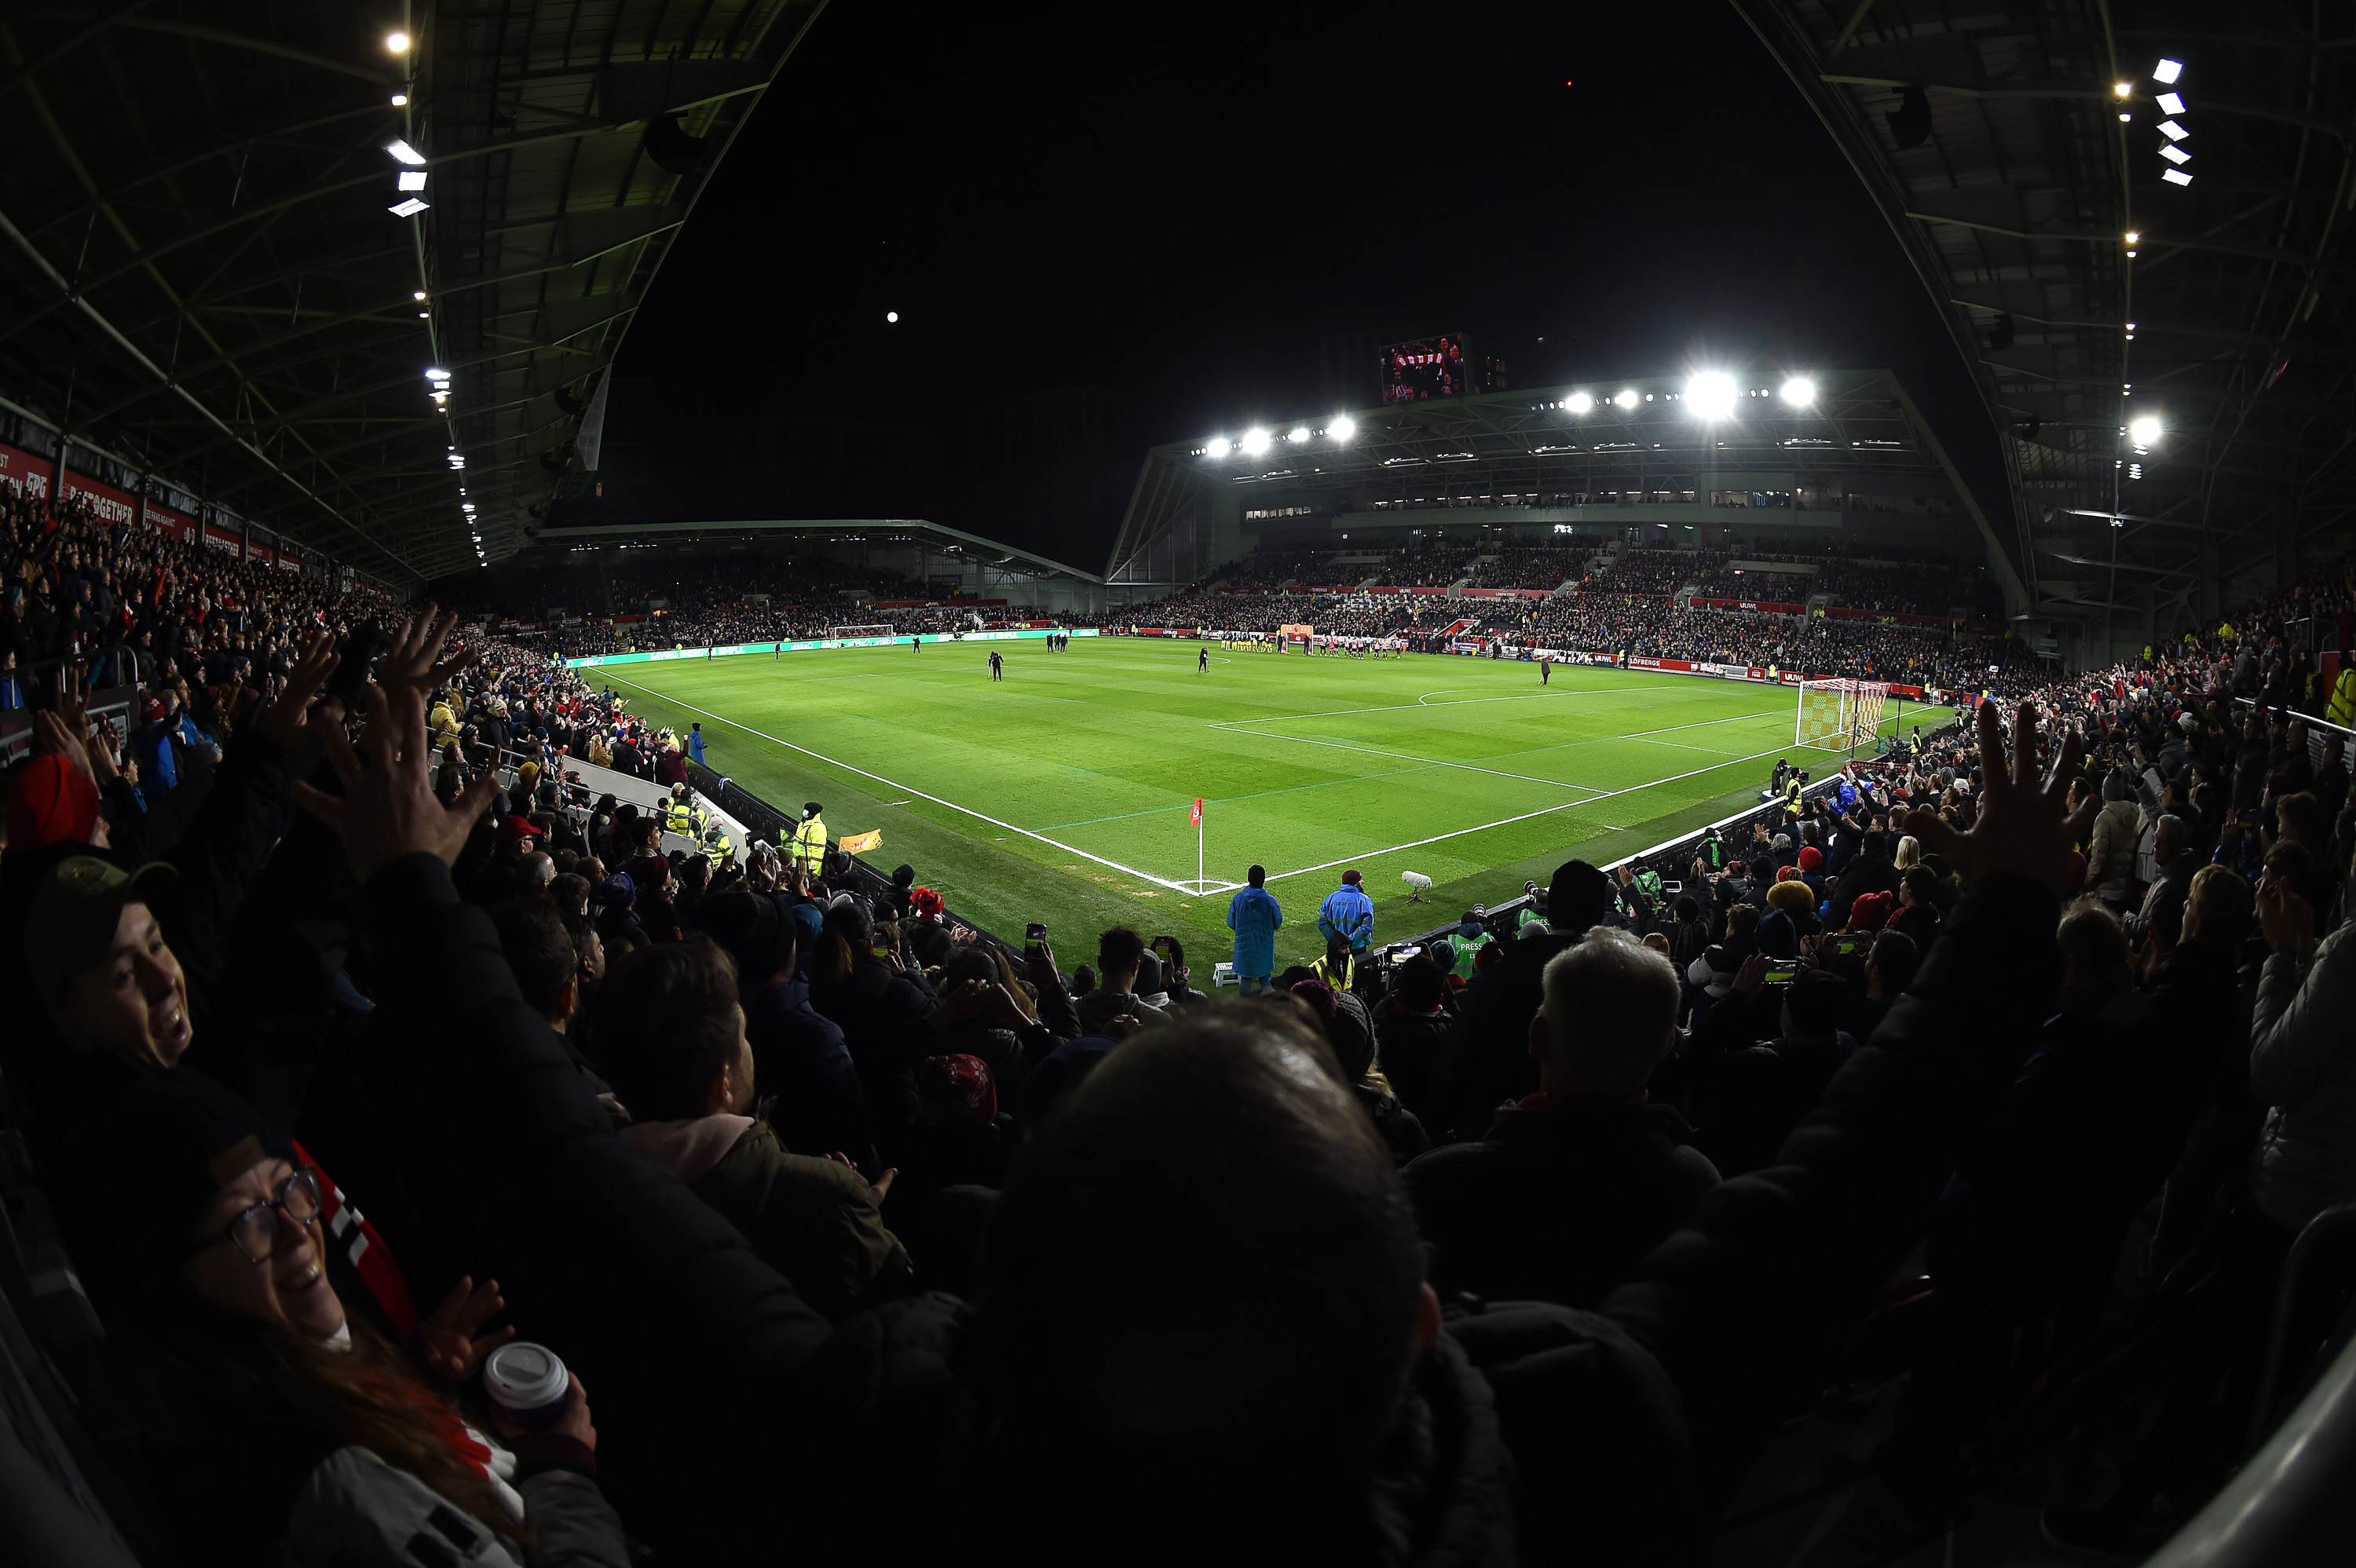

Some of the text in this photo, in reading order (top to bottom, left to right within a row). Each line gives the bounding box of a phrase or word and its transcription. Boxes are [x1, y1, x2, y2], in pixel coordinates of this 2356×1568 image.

[650, 651, 678, 660] SAVING
[680, 649, 709, 659] ENERGY
[1461, 943, 1483, 952] PRESS
